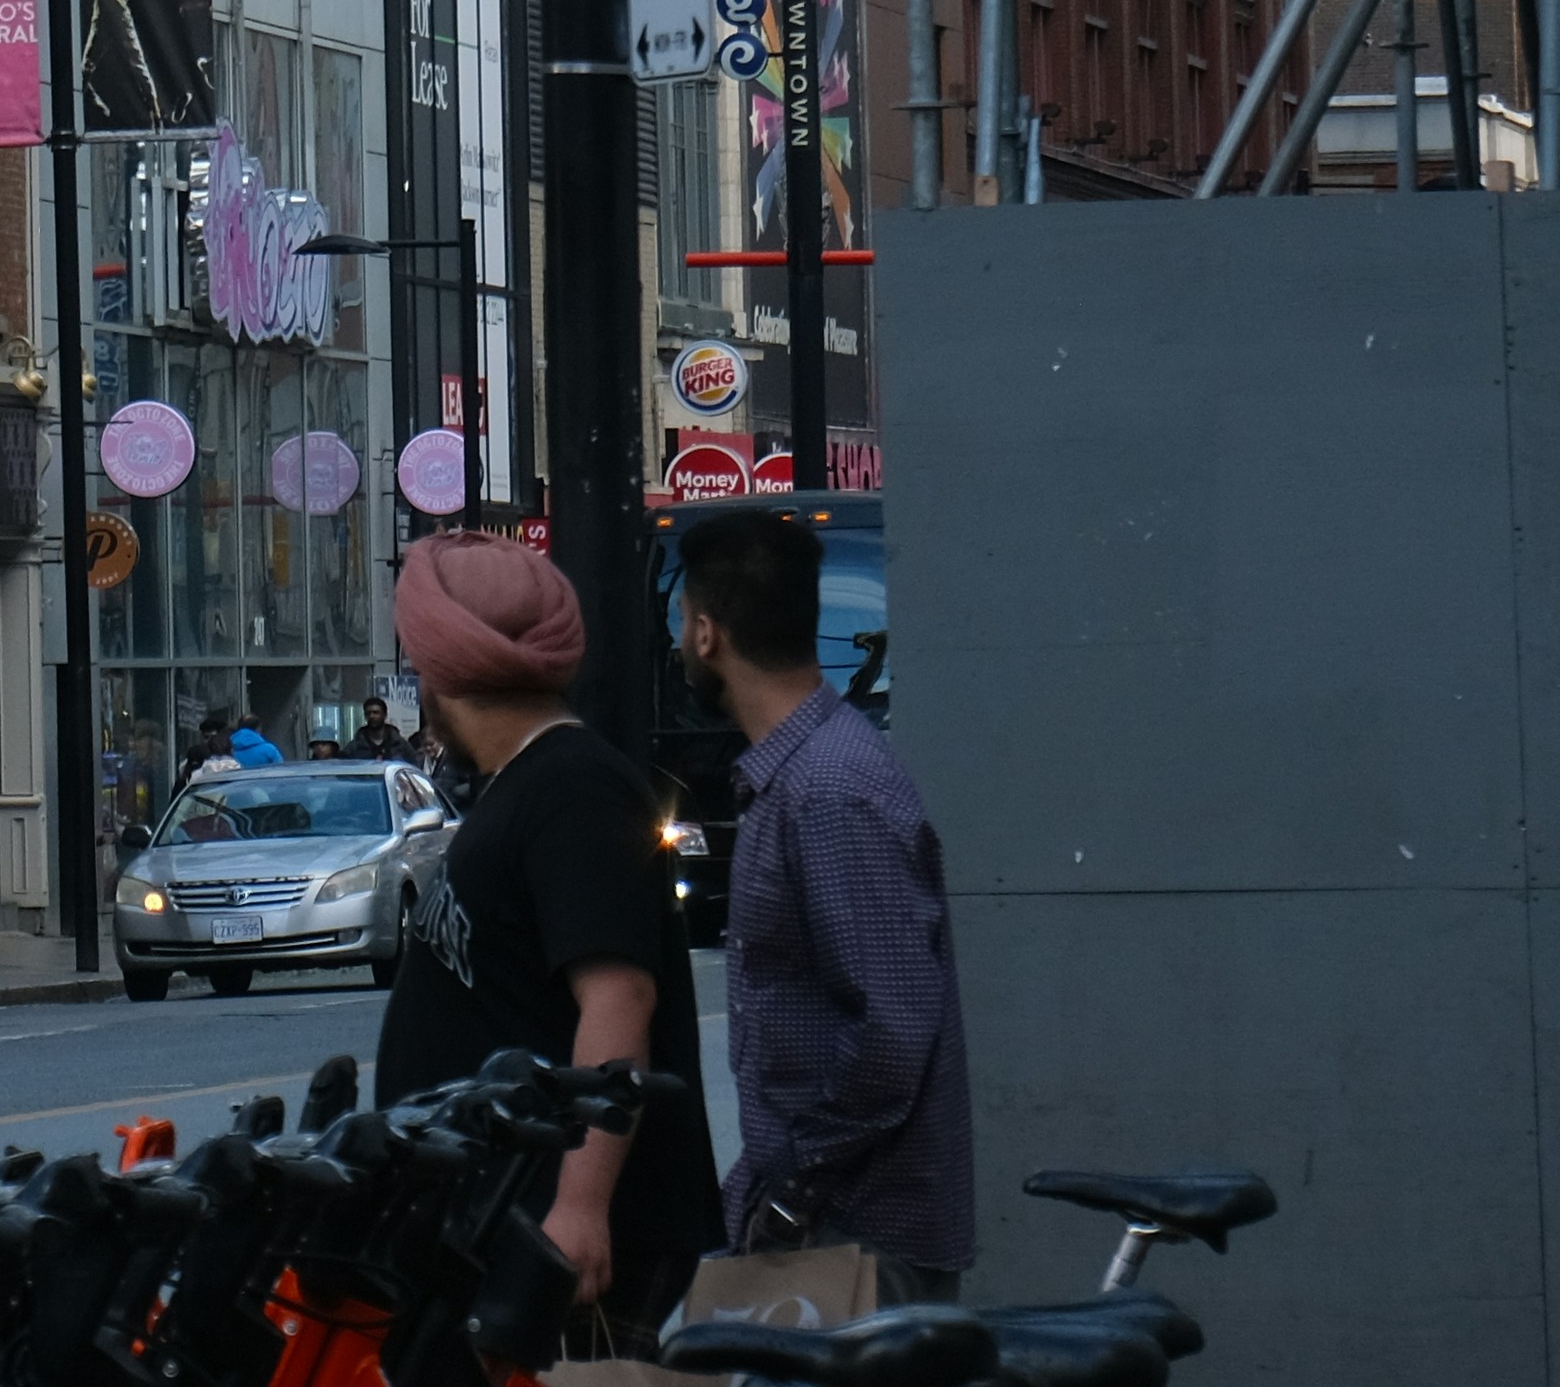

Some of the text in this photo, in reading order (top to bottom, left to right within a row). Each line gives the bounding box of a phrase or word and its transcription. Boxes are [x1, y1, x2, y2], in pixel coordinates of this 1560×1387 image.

[409, 39, 448, 112] Lease
[683, 357, 733, 379] BURGER
[684, 369, 735, 397] KING
[128, 407, 161, 422] OCTO
[160, 411, 186, 443] ZONE
[676, 471, 739, 488] Money
[756, 478, 793, 493] Mon
[388, 678, 418, 707] Notice
